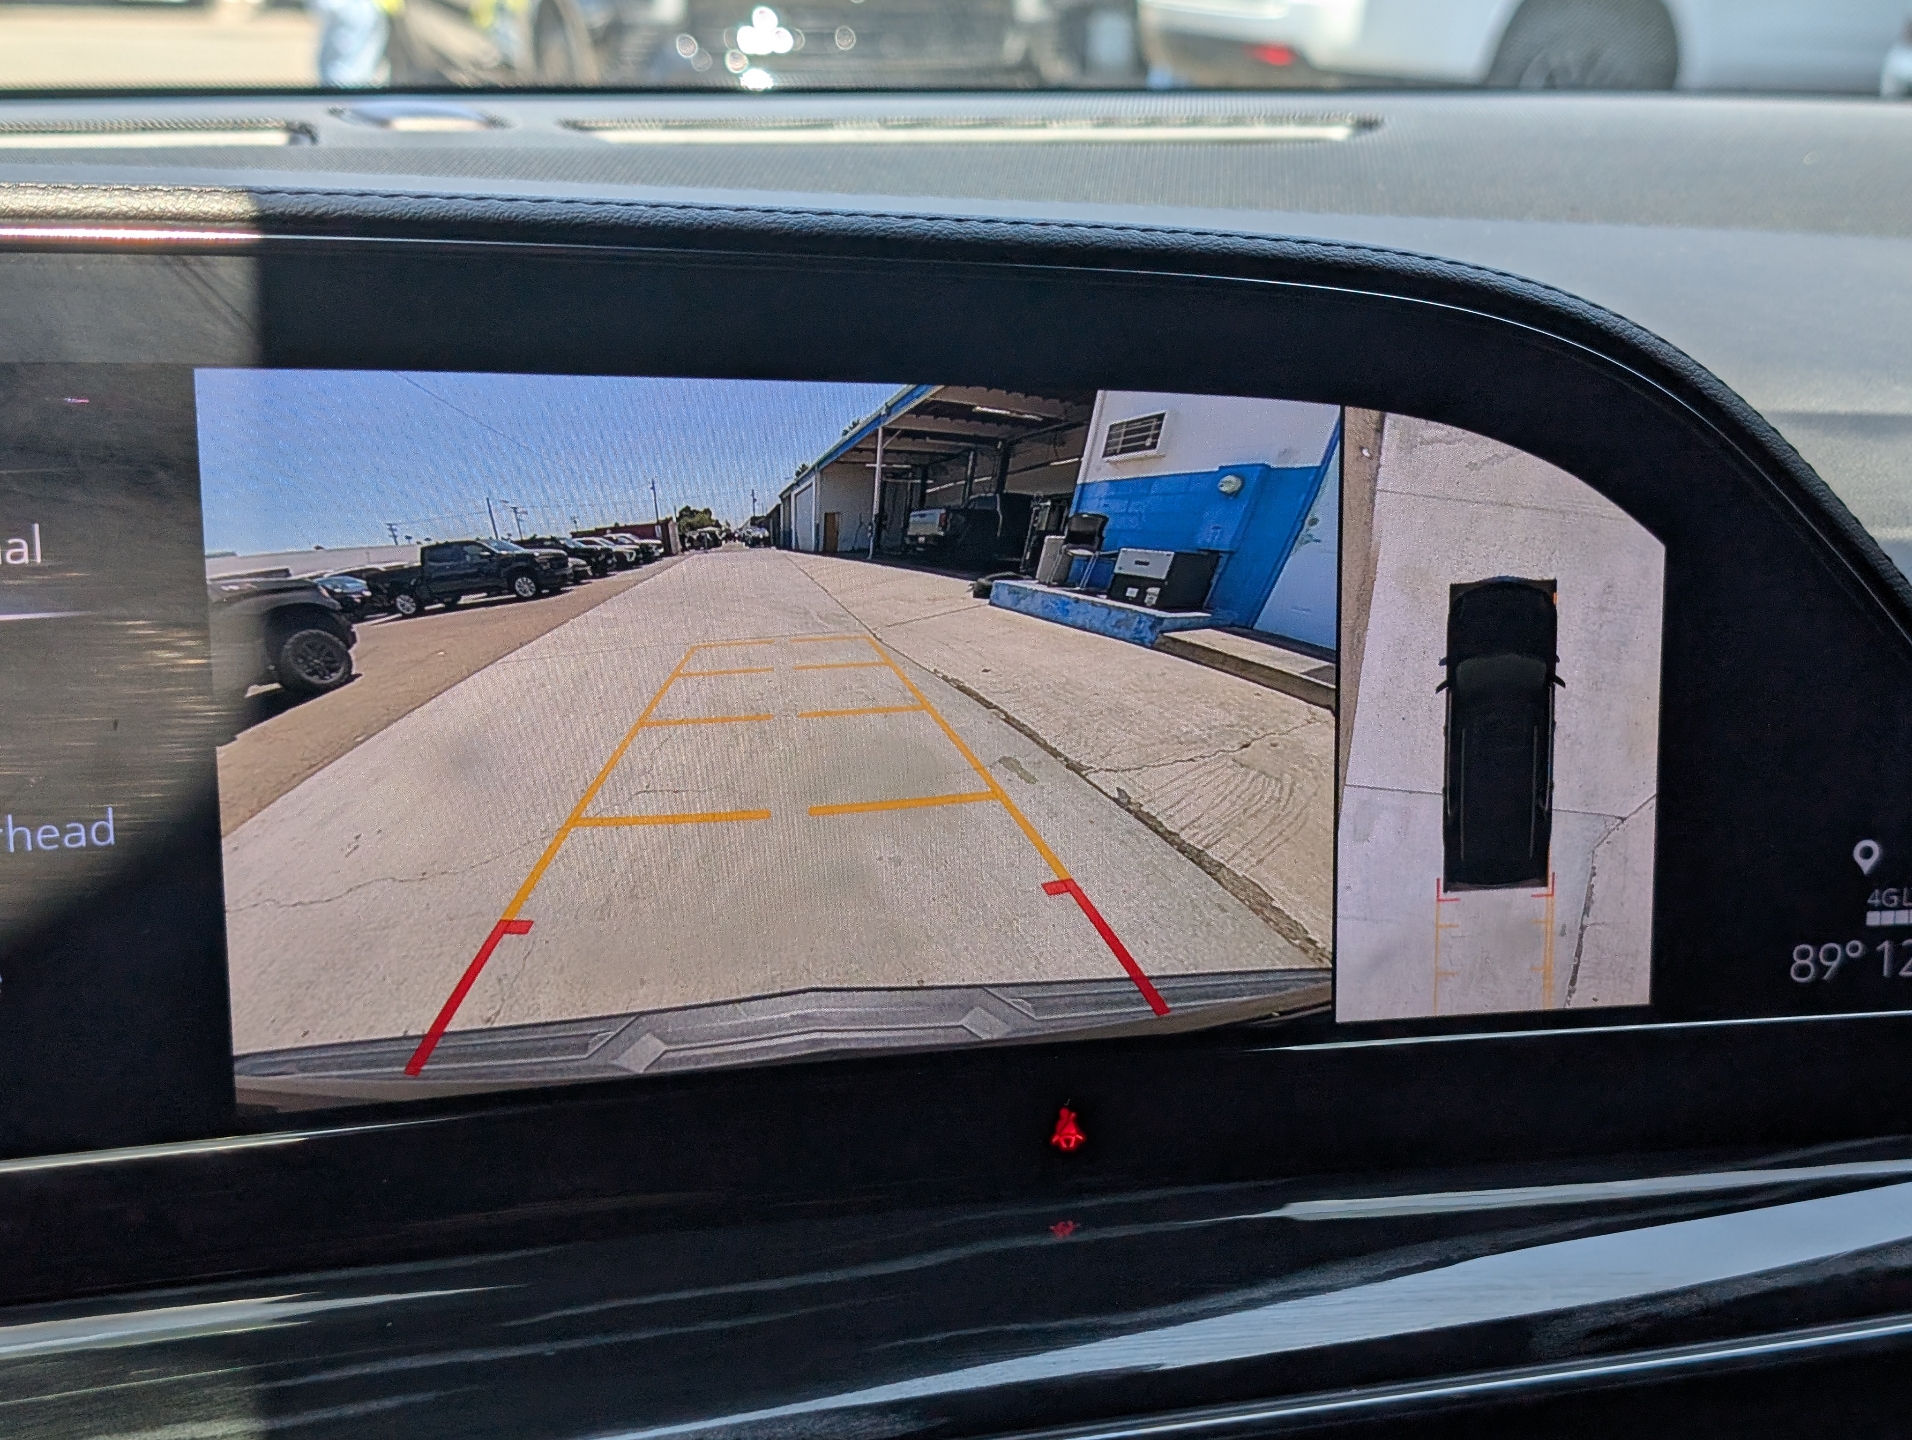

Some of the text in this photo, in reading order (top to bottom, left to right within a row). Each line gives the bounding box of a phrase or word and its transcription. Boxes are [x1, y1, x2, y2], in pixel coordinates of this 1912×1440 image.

[0, 523, 42, 565] al
[0, 806, 116, 853] head
[1866, 887, 1912, 908] 4GL
